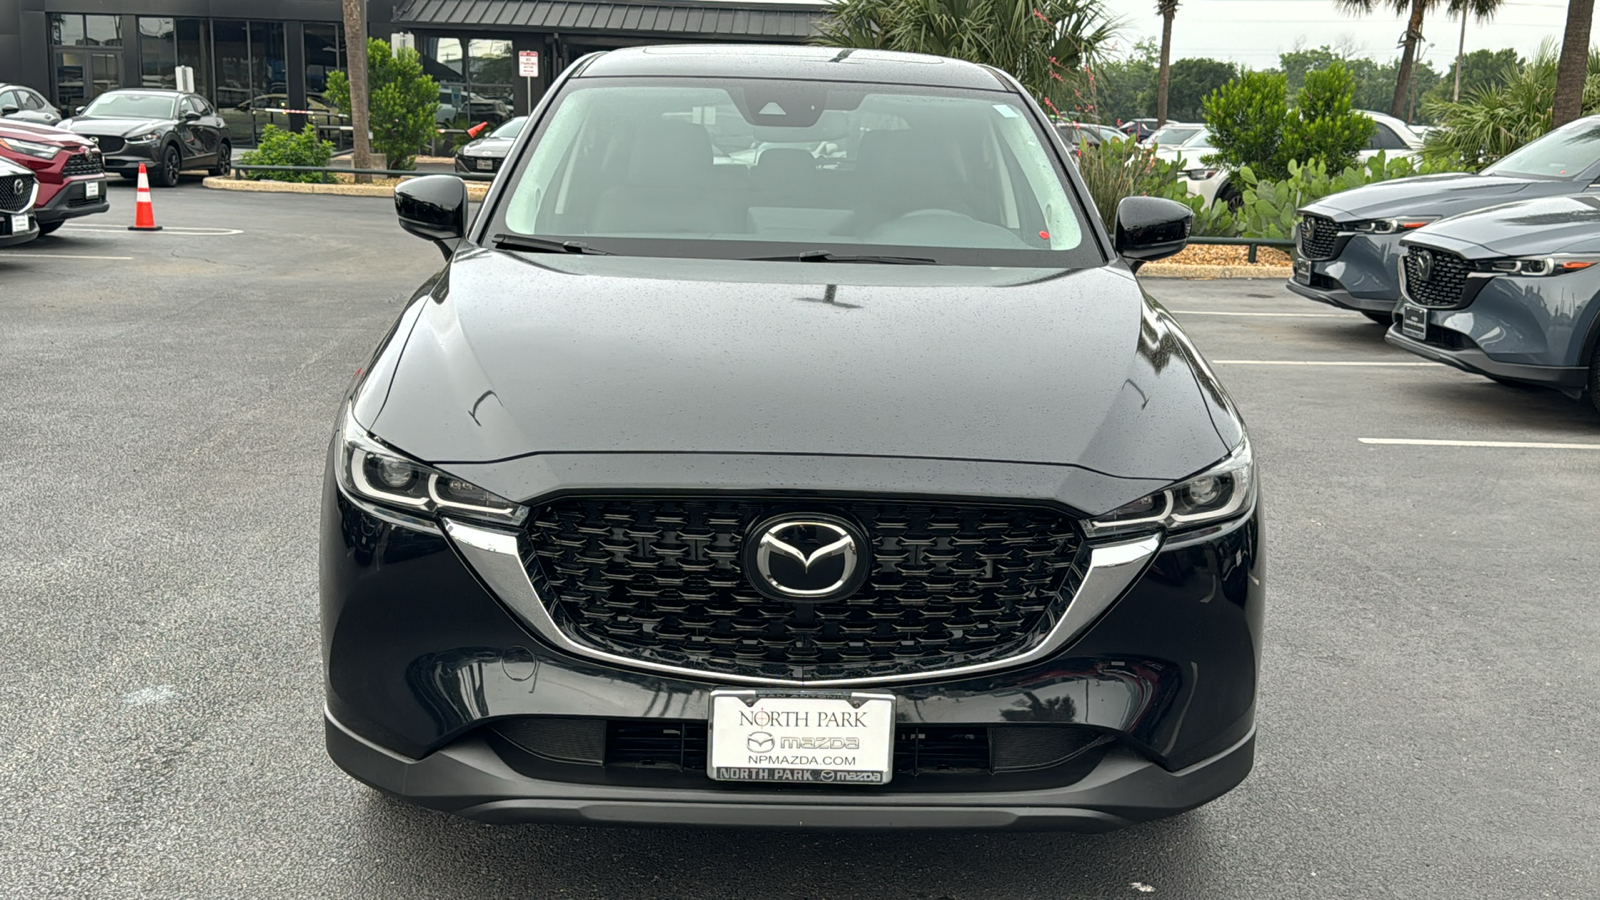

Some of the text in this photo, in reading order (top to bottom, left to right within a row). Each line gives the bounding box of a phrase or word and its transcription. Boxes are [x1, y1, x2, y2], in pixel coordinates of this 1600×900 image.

[739, 709, 869, 728] NORTH PARK
[780, 736, 860, 750] mazda
[748, 755, 856, 766] NPMAZDA.COM
[719, 767, 881, 782] NORTH PARK mazda
